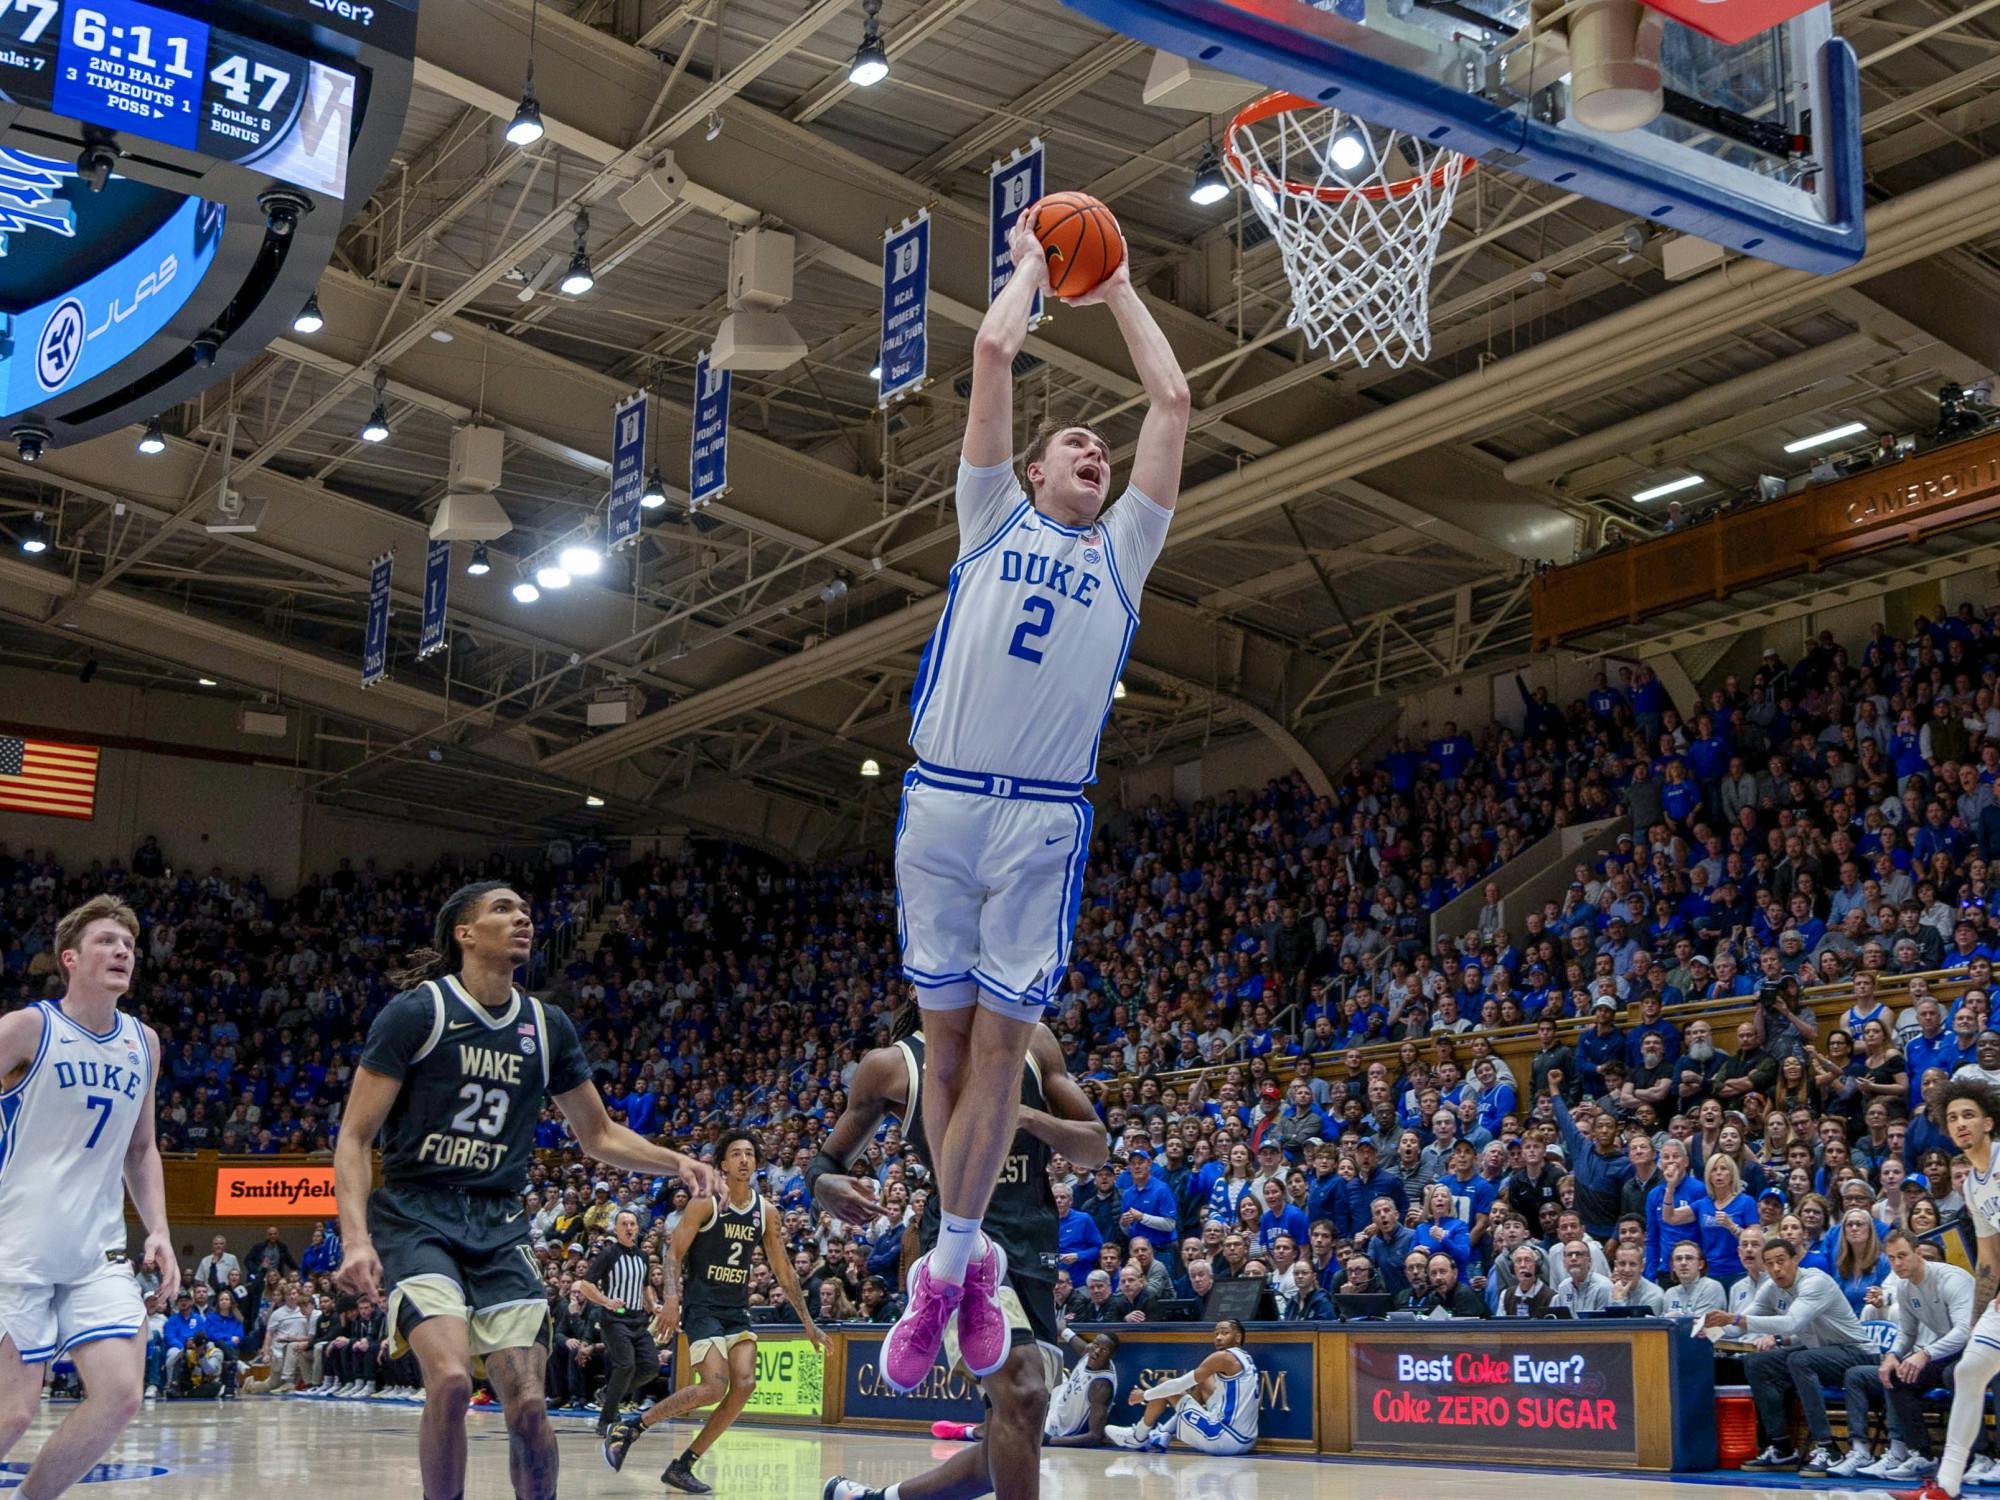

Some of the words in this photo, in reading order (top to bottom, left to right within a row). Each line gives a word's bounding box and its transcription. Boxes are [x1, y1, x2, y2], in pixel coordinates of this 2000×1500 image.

[72, 8, 193, 79] 6:11
[66, 67, 78, 81] 3
[86, 72, 175, 108] TIMEOUTS
[182, 99, 192, 113] 1
[89, 56, 125, 77] 2ND
[128, 67, 176, 91] HALF
[210, 55, 291, 113] 47
[106, 94, 151, 117] POSS
[211, 102, 258, 128] Fouls:
[210, 119, 261, 144] BONUS
[894, 287, 915, 307] NCAA
[882, 330, 904, 353] FINAL
[904, 321, 924, 345] FOUR
[887, 303, 921, 332] WOMEN'S
[1846, 464, 1979, 524] CAMERON
[1000, 551, 1101, 608] DUKE
[1008, 594, 1055, 665] 2
[54, 1060, 141, 1101] DUKE
[459, 1044, 524, 1085] WAKE
[84, 1095, 113, 1149] 7
[451, 1083, 510, 1137] 23
[418, 1133, 508, 1172] FOREST
[724, 1223, 755, 1241] WAKE
[727, 1241, 743, 1265] 2
[707, 1264, 748, 1284] FOREST
[1398, 1354, 1453, 1382] Best
[1455, 1352, 1511, 1383] Coke
[1513, 1355, 1585, 1383] Ever?
[1373, 1389, 1433, 1424] Coke
[1437, 1396, 1510, 1427] ZERO
[1517, 1397, 1617, 1430] SUGAR
